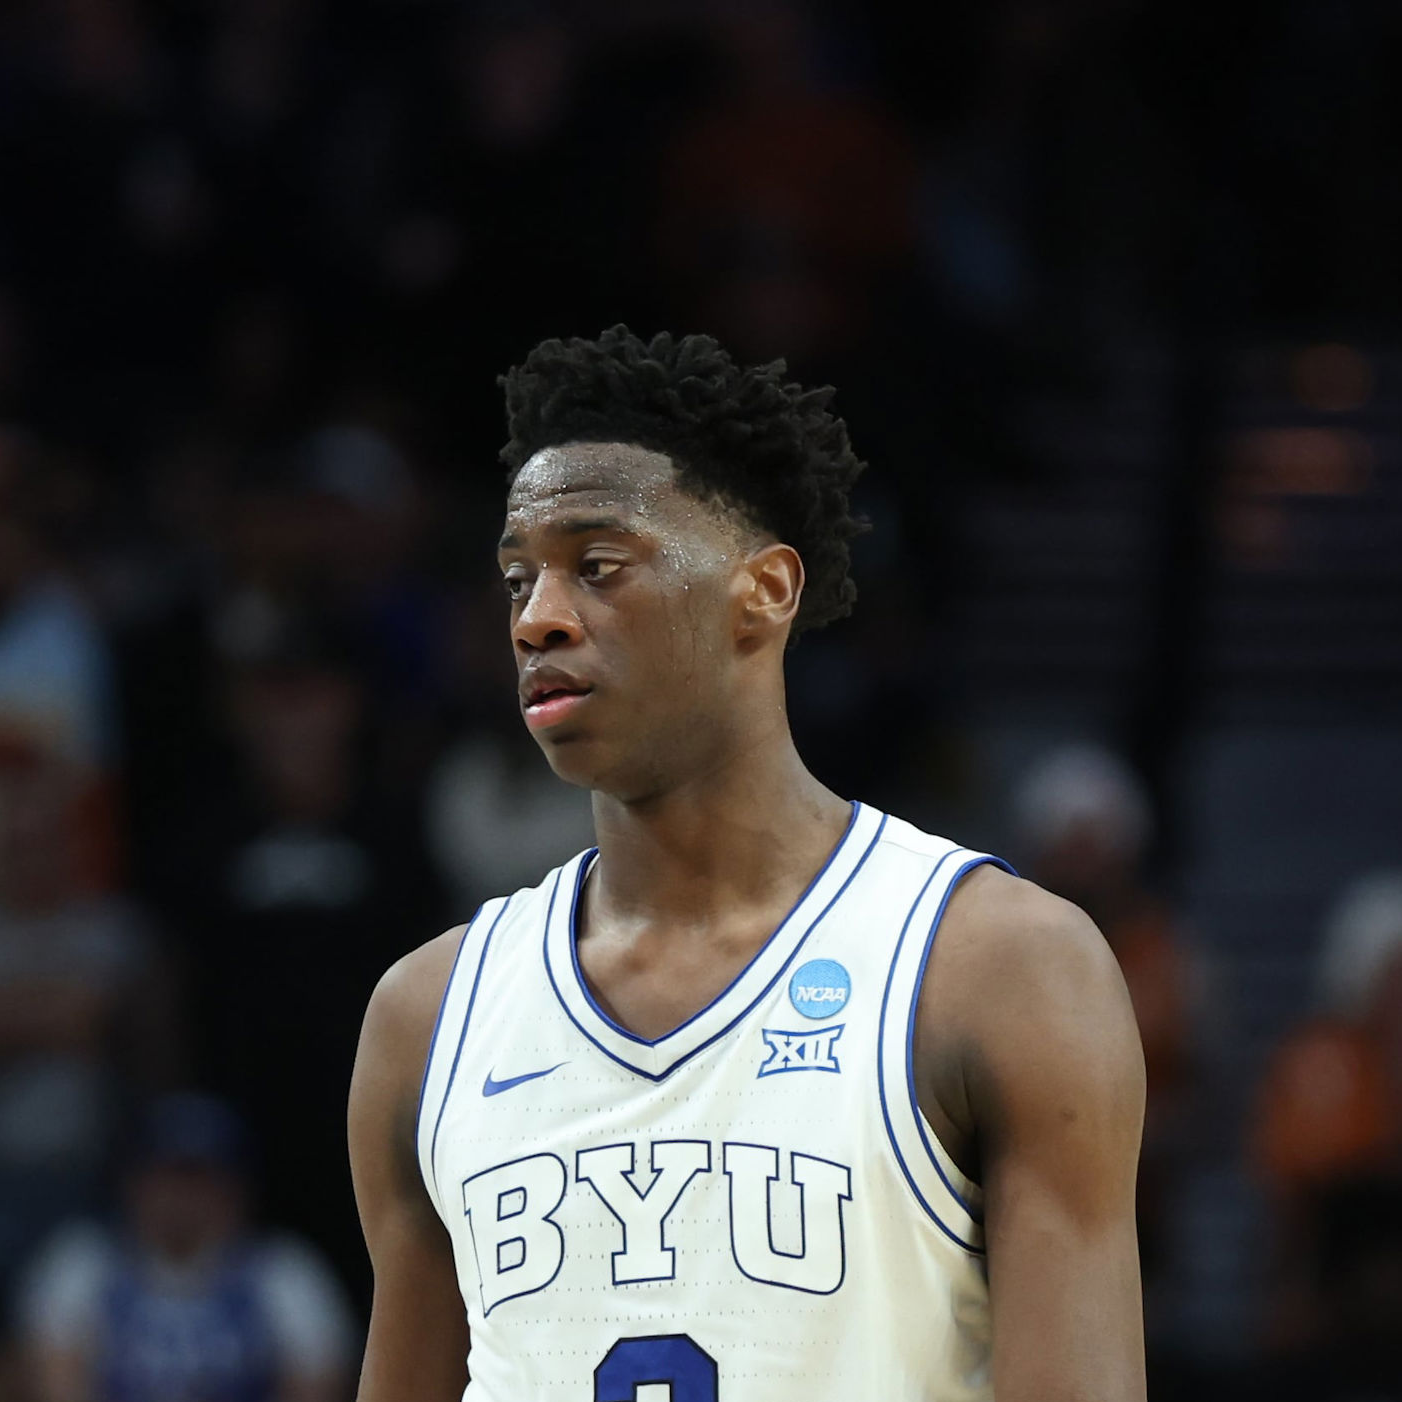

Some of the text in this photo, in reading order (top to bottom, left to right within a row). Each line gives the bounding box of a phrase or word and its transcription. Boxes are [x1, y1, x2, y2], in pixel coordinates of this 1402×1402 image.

[796, 986, 847, 1003] NCAA
[756, 1023, 846, 1080] XII
[461, 1140, 853, 1318] BYU
